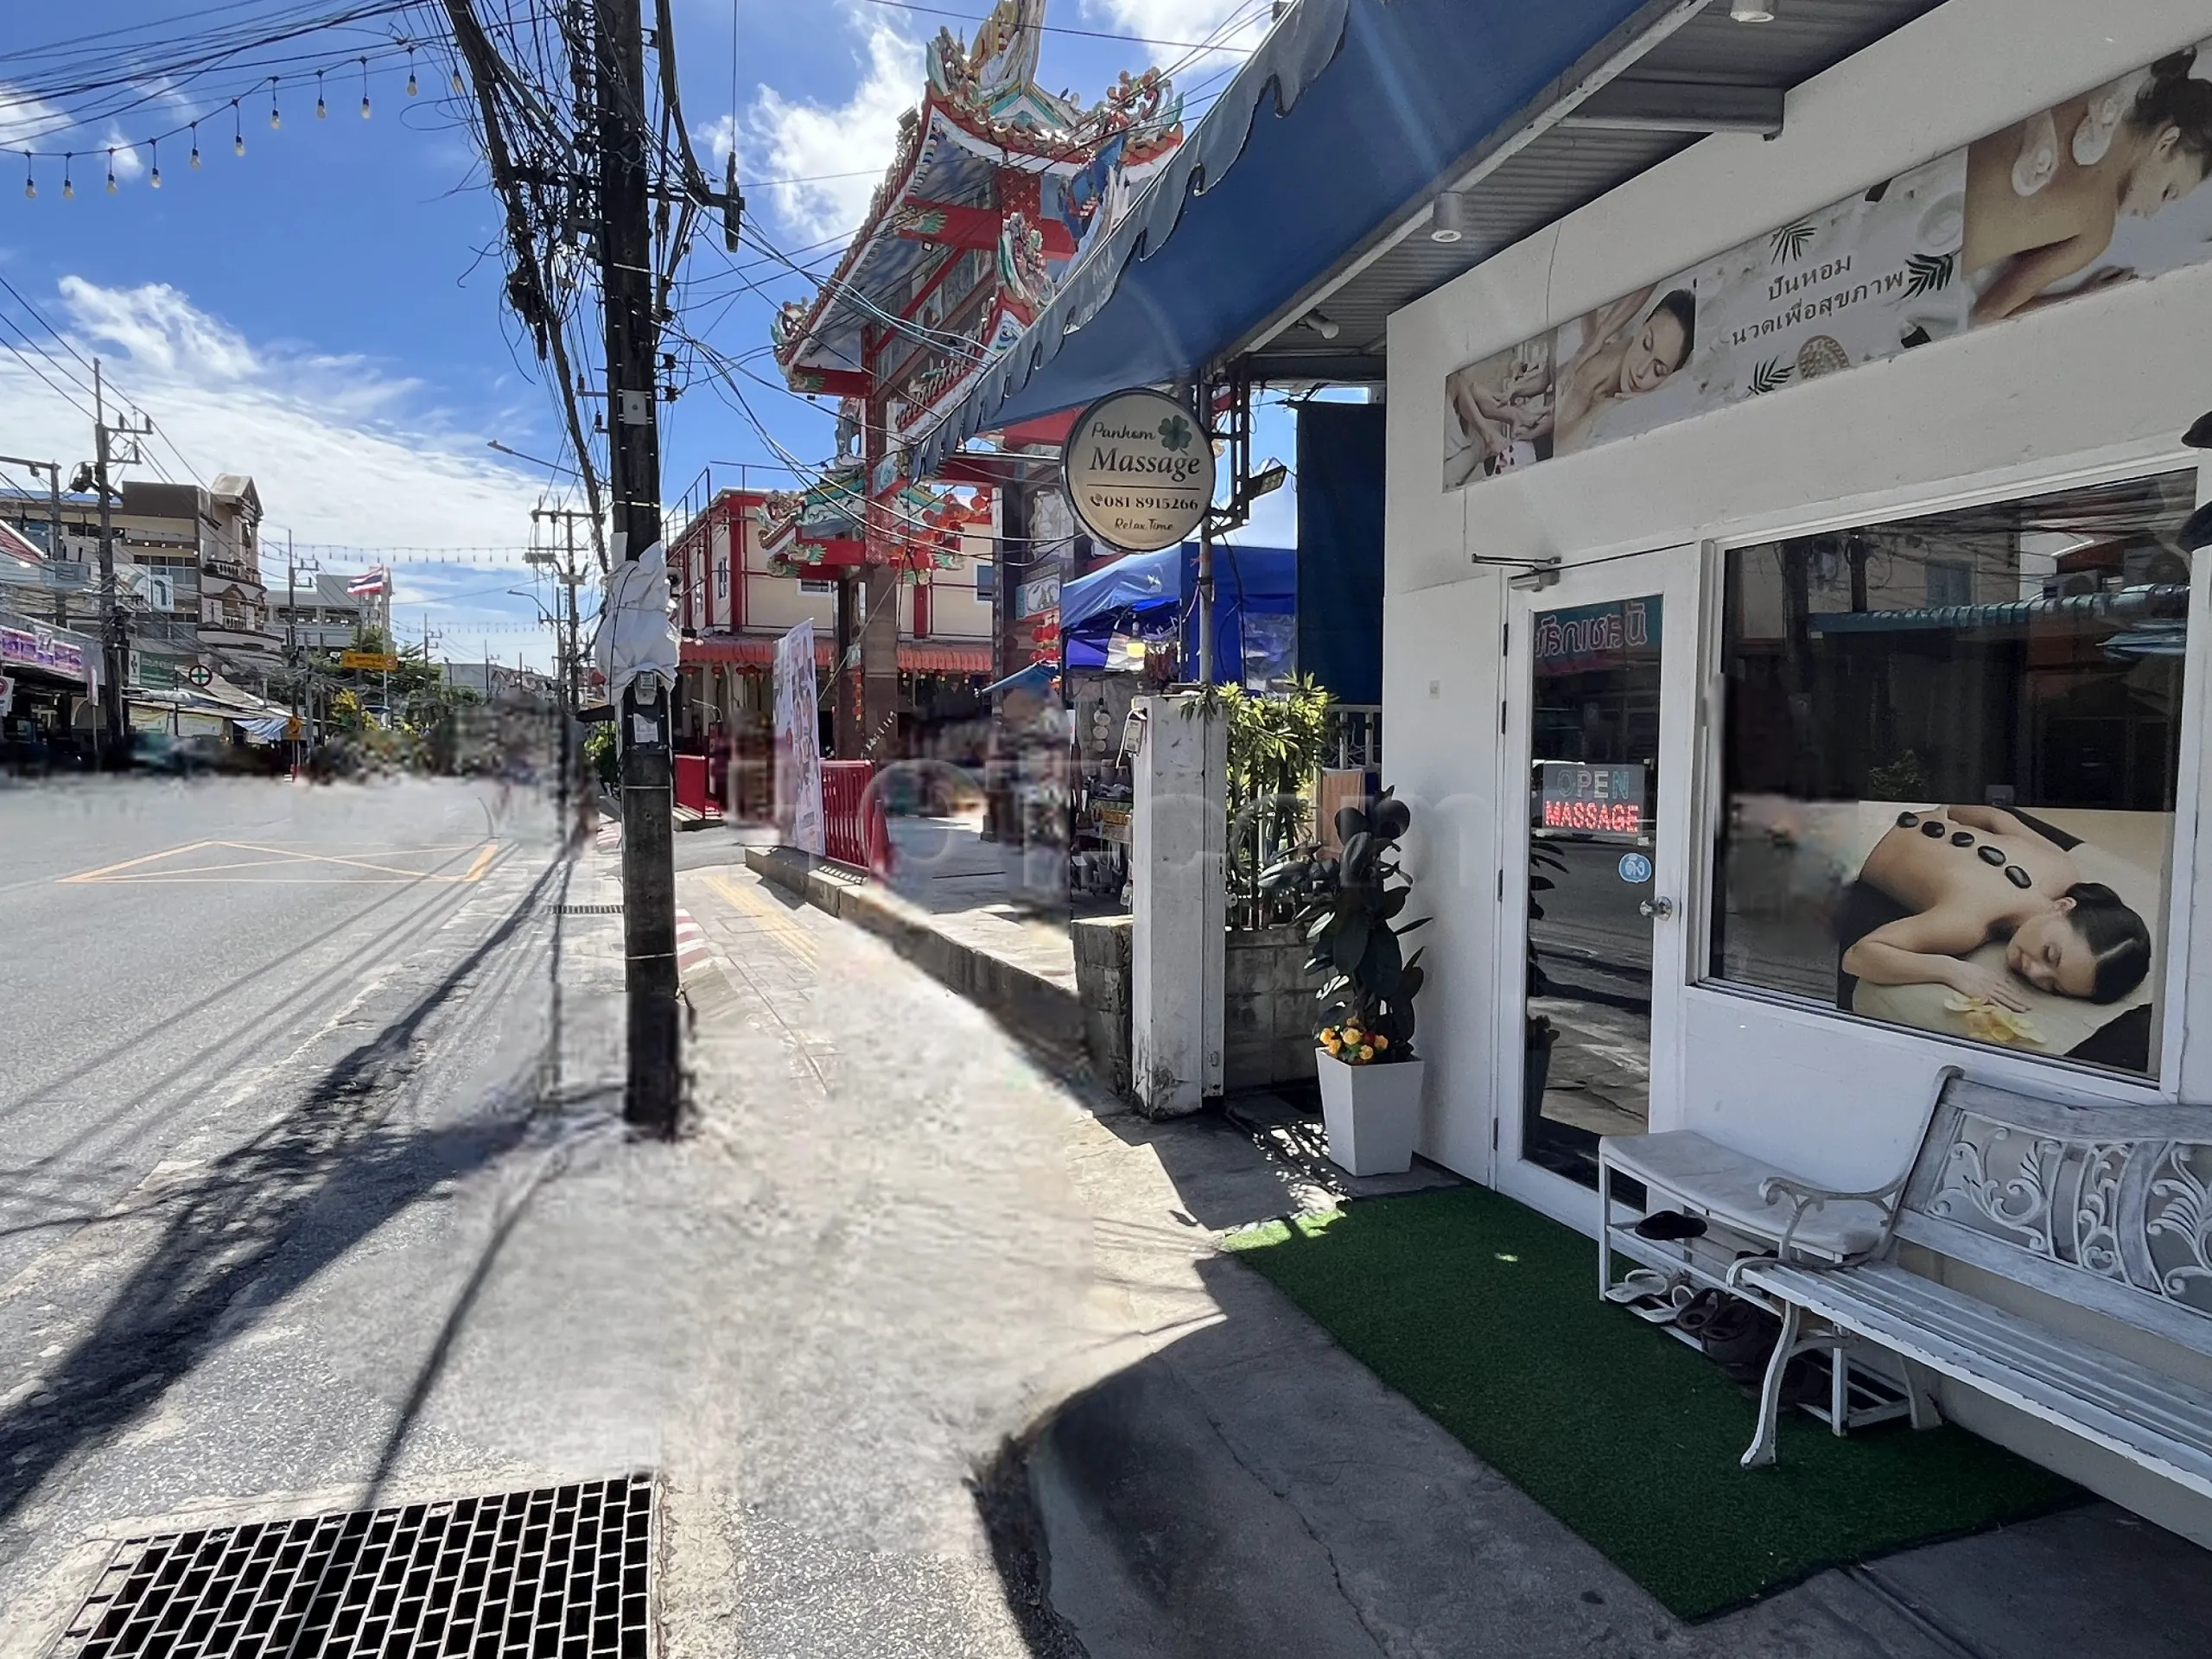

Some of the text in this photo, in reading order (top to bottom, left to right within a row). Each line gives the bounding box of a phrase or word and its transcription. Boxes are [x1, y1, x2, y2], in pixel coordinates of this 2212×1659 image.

[1768, 255, 1852, 302] ปันหอม
[1732, 270, 1904, 346] นวดเพื่อสุขภาพ
[1088, 446, 1201, 483] Massage
[1103, 496, 1198, 511] 081 8915266
[1115, 518, 1174, 531] Relax Time
[1557, 769, 1630, 800] OPEN
[1544, 800, 1639, 833] MASSAGE
